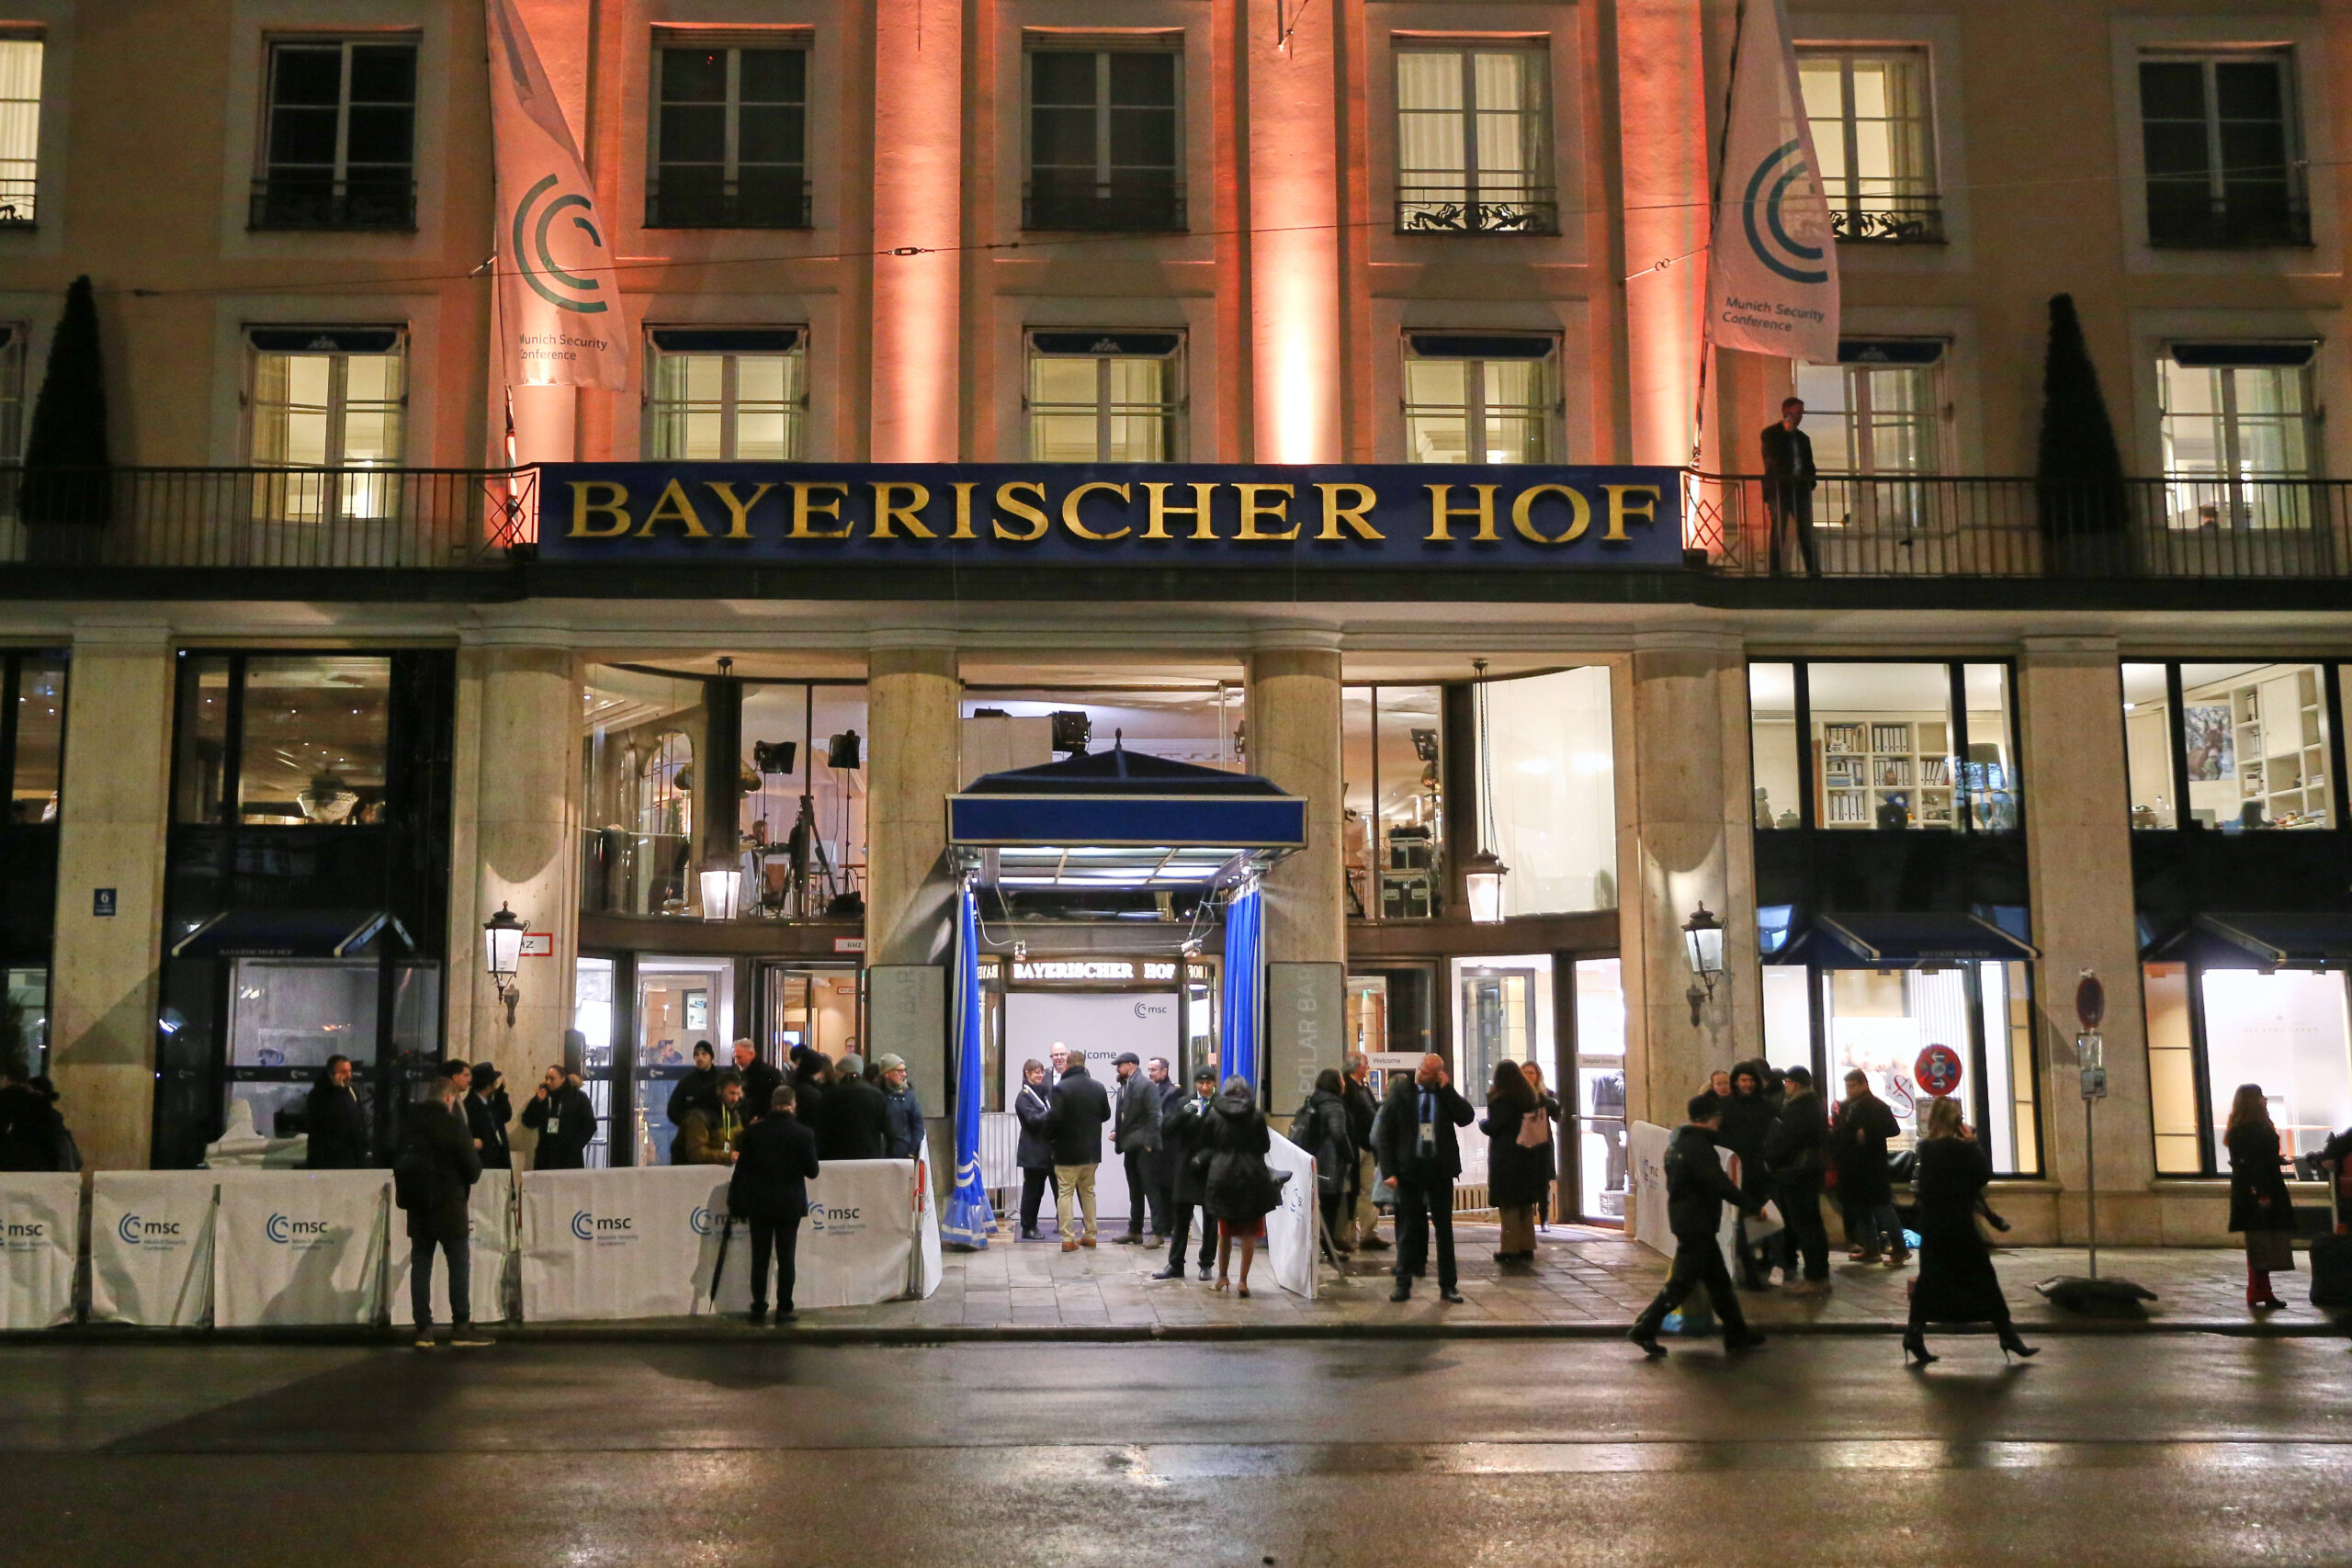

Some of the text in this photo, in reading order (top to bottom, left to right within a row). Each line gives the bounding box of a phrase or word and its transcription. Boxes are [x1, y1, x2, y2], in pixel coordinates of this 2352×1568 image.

[1725, 297, 1825, 322] Munich Security
[1723, 311, 1792, 332] Conference
[560, 334, 608, 351] Security
[563, 478, 1661, 543] BAYERISCHER HOF
[101, 891, 109, 904] 6
[1012, 963, 1176, 979] BAYERISCHER HOF
[1148, 1005, 1167, 1014] msc
[1070, 1049, 1117, 1059] lcome
[1297, 1019, 1318, 1093] POLAR
[828, 1208, 860, 1220] msc
[8, 1224, 43, 1236] msc
[144, 1222, 180, 1235] msc
[292, 1221, 327, 1234] msc
[597, 1217, 631, 1230] msc
